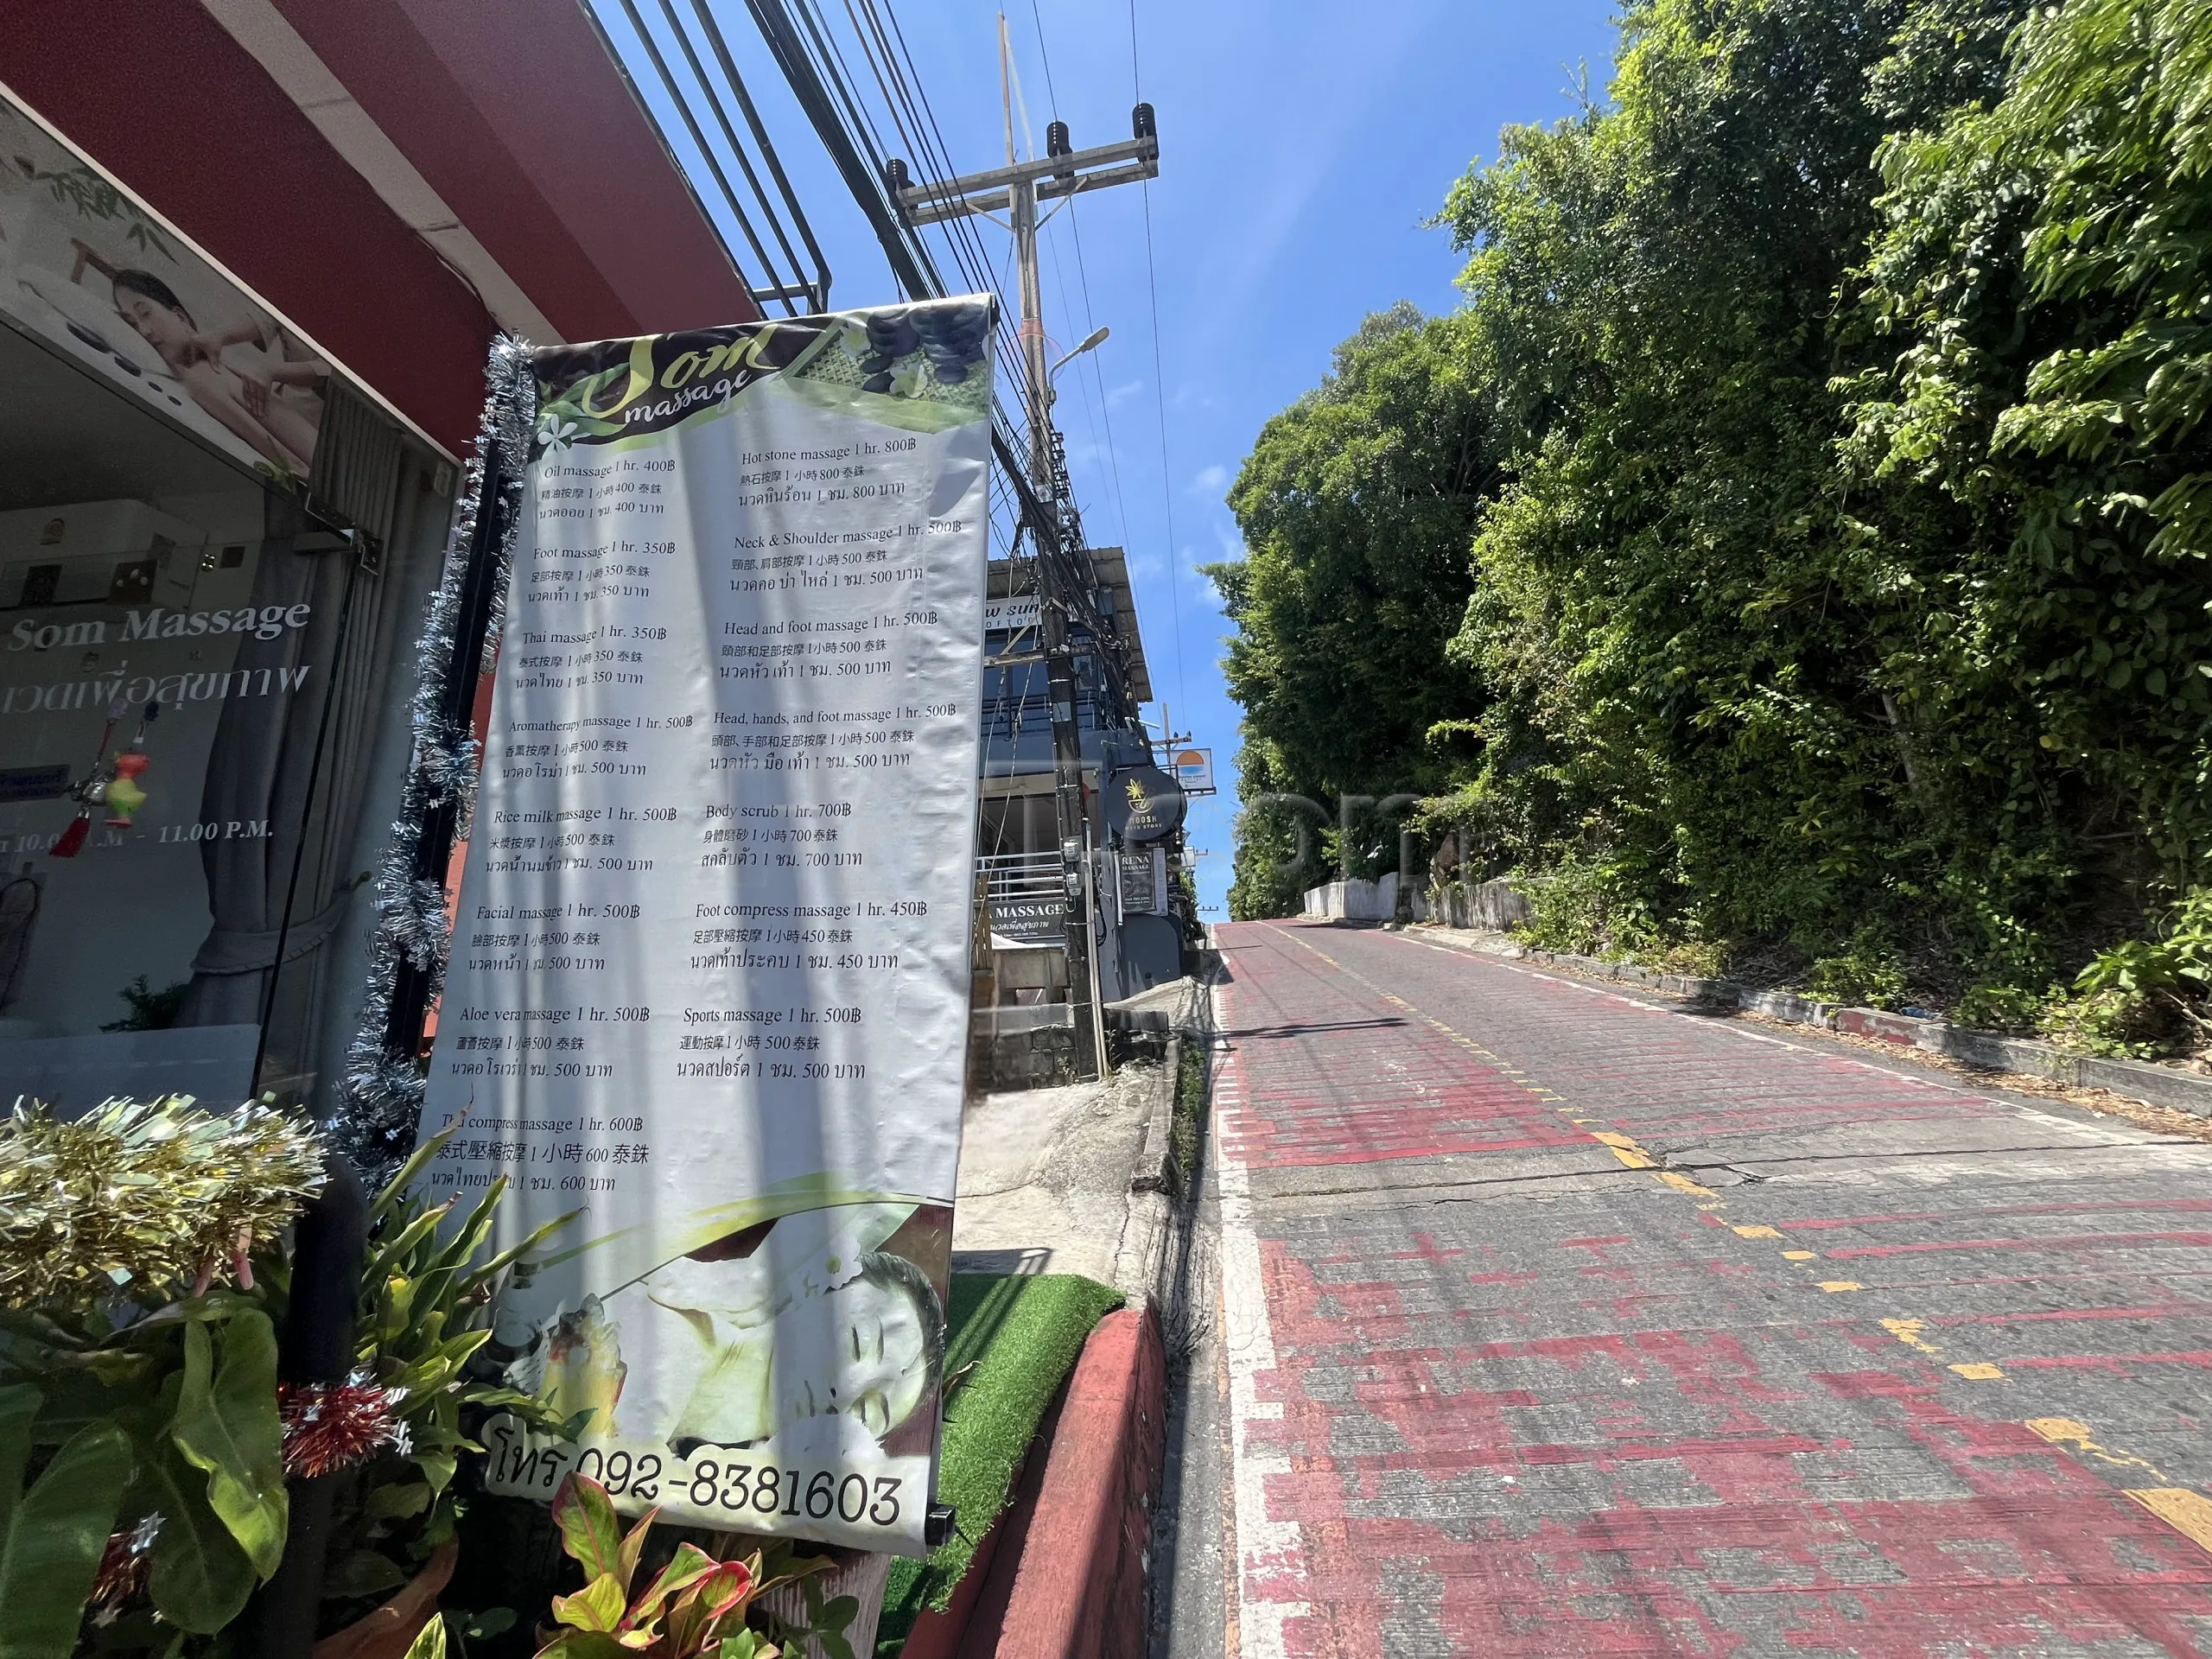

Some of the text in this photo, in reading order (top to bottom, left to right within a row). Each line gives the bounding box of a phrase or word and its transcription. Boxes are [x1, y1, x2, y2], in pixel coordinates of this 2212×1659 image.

[625, 370, 752, 423] massage
[741, 452, 761, 465] Hot
[765, 449, 797, 461] stone
[800, 447, 850, 460] massage
[864, 442, 880, 454] hr.
[544, 466, 560, 478] Oil
[564, 466, 613, 478] massage
[624, 460, 639, 471] hr.
[734, 536, 765, 549] Neck
[769, 534, 779, 546] &
[784, 532, 839, 545] Shoulder
[842, 530, 893, 542] massage
[908, 524, 924, 536] hr.
[533, 548, 557, 560] Foot
[562, 545, 607, 558] massage
[621, 540, 637, 552] hr.
[8, 603, 311, 652] Som Massage
[724, 622, 758, 635] Head
[762, 622, 784, 634] and
[787, 620, 811, 632] foot
[816, 620, 868, 632] massage
[884, 615, 899, 627] hr.
[523, 631, 546, 645] Thai
[550, 629, 597, 644] massage
[609, 625, 626, 637] hr.
[509, 719, 582, 733] Aromatherapy
[582, 716, 631, 730] massage
[646, 718, 662, 729] hr.
[714, 712, 748, 724] Head,
[753, 713, 789, 725] hands,
[793, 712, 813, 723] and
[817, 710, 840, 722] foot
[843, 709, 892, 722] massage
[906, 707, 921, 718] hr.
[494, 810, 519, 823] Rice
[524, 810, 553, 823] milk
[556, 808, 601, 822] massage
[620, 807, 638, 821] hr.
[706, 804, 737, 820] Body
[741, 804, 778, 817] scrub
[796, 804, 812, 817] hr.
[159, 822, 218, 842] 11.00
[225, 820, 274, 839] P.M.
[477, 906, 513, 920] Facial
[519, 906, 563, 920] massage
[578, 903, 596, 917] hr.
[696, 904, 721, 917] Foot
[724, 904, 789, 919] compress
[793, 905, 850, 919] massage
[868, 902, 886, 916] hr.
[996, 904, 1064, 918] MASSAGE
[460, 1007, 489, 1020] Aloe
[494, 1009, 521, 1021] vera
[524, 1008, 570, 1027] massage
[589, 1007, 607, 1021] hr.
[683, 1007, 720, 1026] Sports
[723, 1008, 782, 1025] massage
[800, 1007, 818, 1023] hr.
[468, 1117, 518, 1132] compress
[519, 1117, 573, 1133] massage
[589, 1117, 604, 1130] hr.
[577, 1447, 901, 1526] 092-8381603
